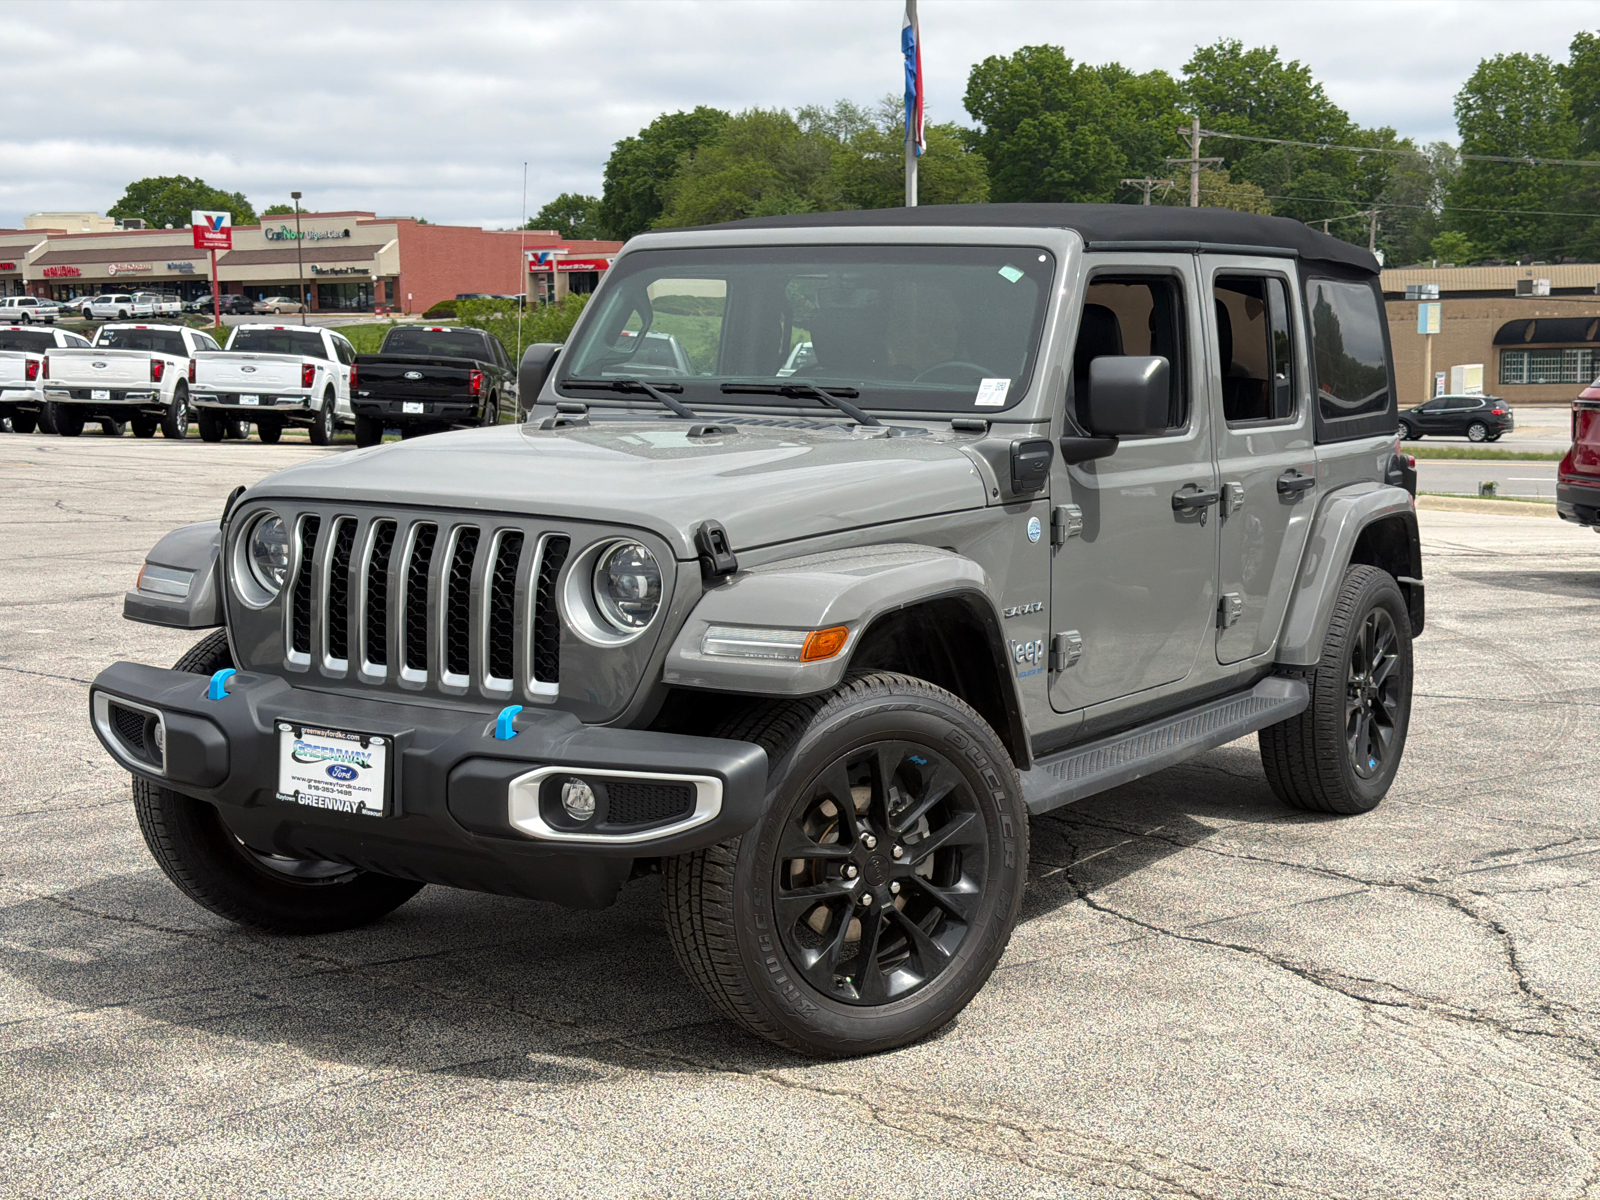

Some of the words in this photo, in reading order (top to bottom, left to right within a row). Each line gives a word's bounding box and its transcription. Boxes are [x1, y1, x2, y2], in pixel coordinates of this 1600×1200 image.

[301, 727, 360, 741] greenwayfordkc.com
[293, 740, 372, 765] GREENWAY
[332, 765, 352, 779] Ford
[291, 775, 372, 792] www.greenwayfordkc.com
[308, 784, 353, 796] 816-353-1495
[276, 793, 295, 801] Raytown
[298, 793, 359, 813] GREENWAY
[362, 809, 382, 817] Missouri
[944, 729, 1016, 869] DUELER
